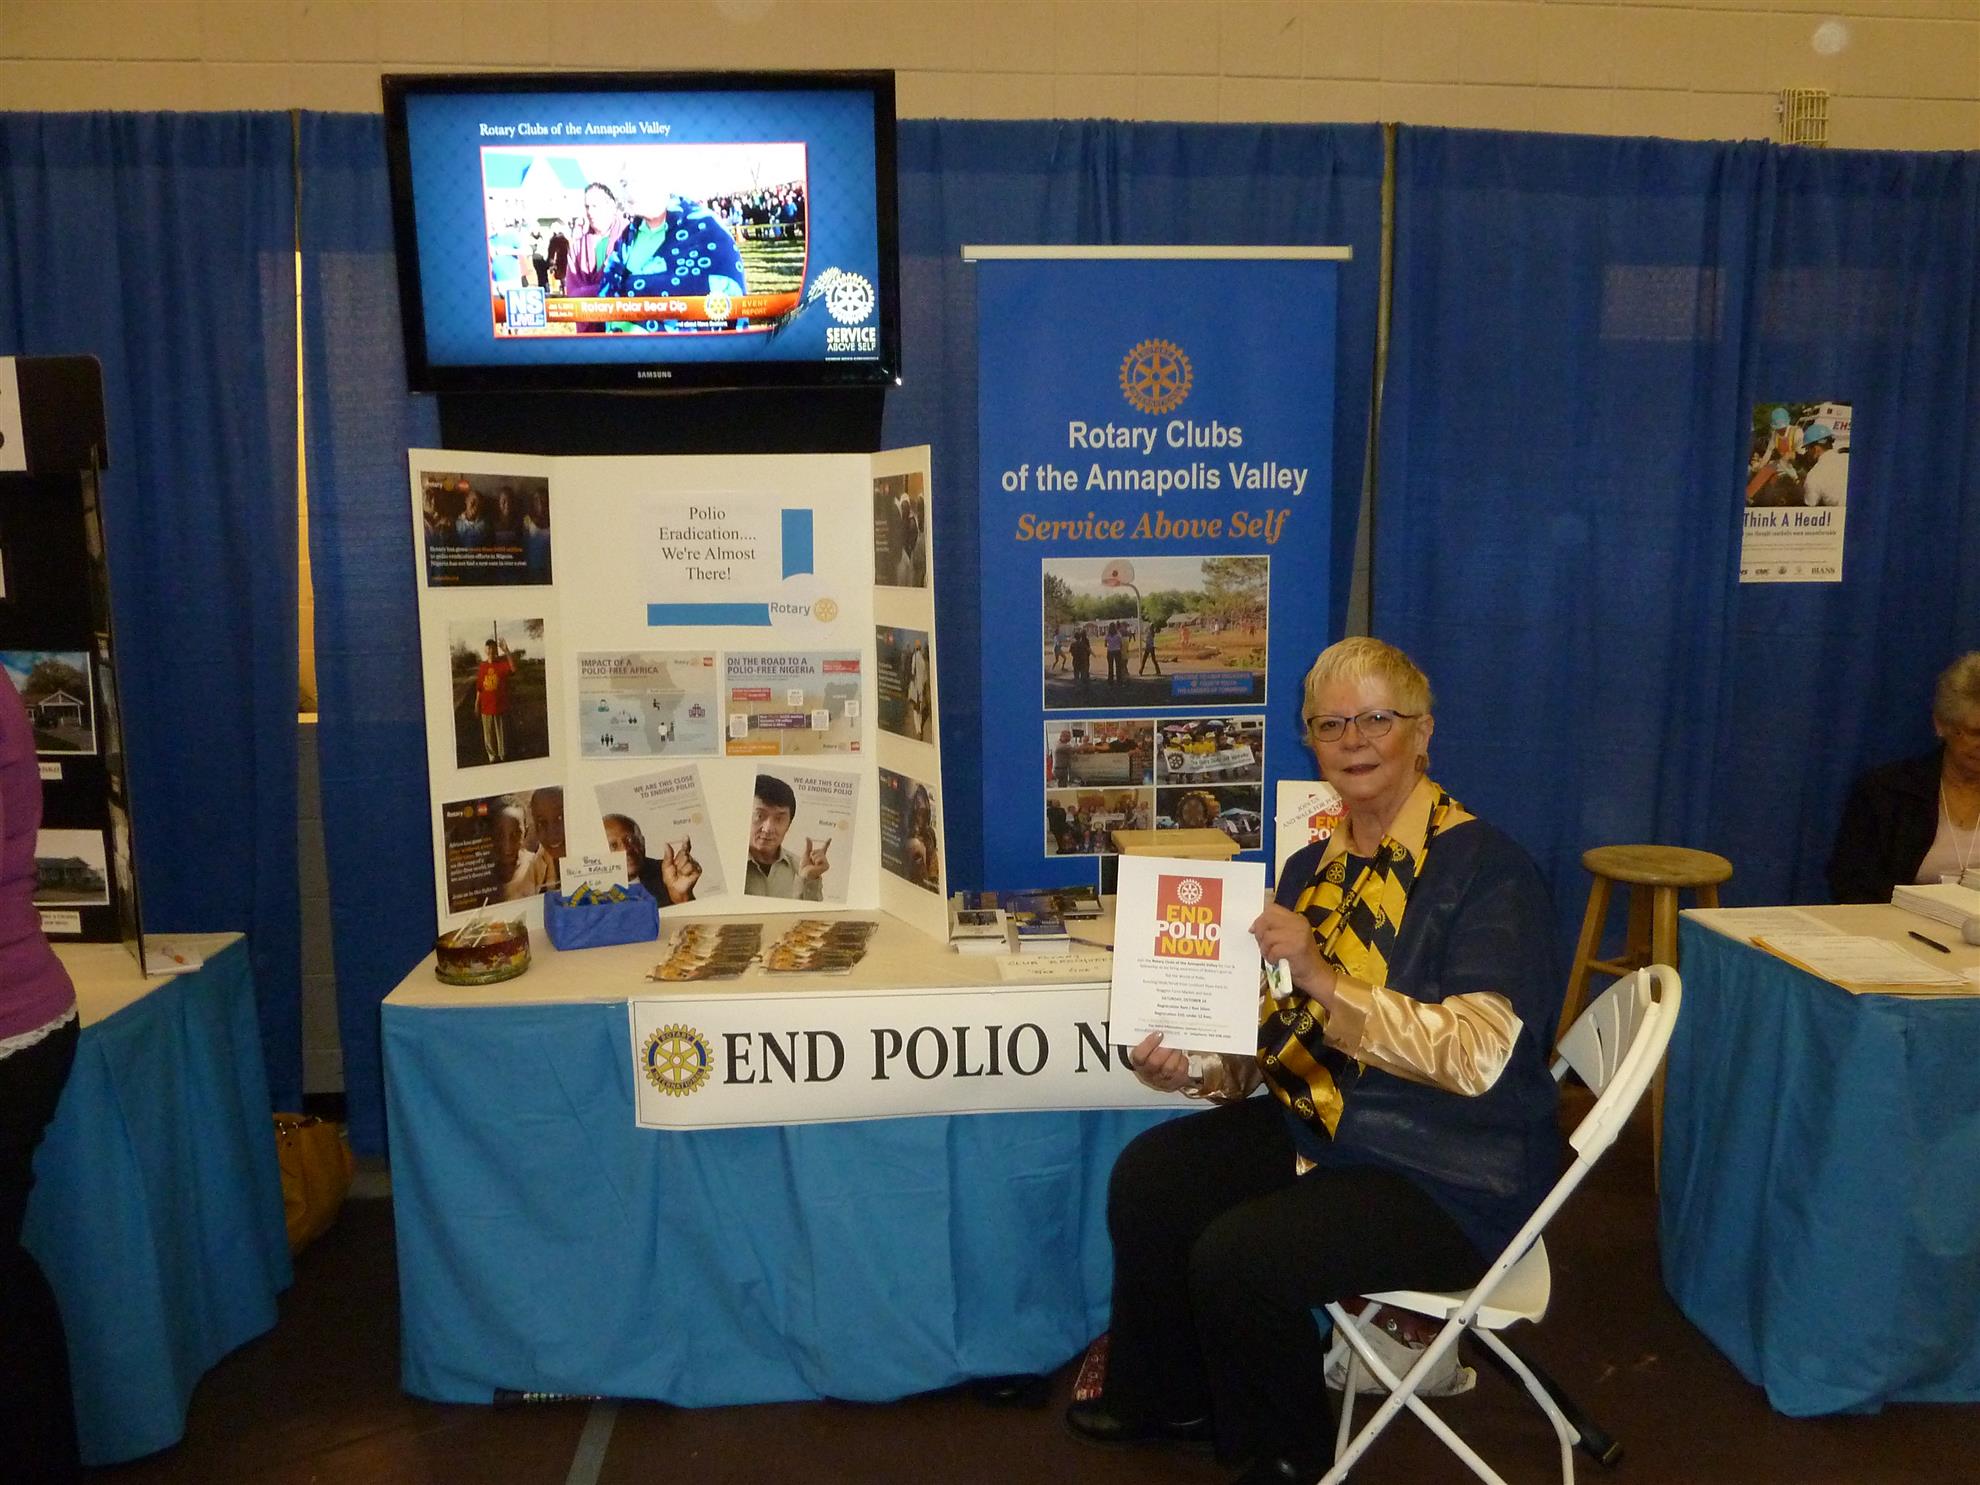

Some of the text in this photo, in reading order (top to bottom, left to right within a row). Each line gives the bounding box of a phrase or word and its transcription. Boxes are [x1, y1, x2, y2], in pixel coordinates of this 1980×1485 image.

[480, 121, 671, 138] Rotary Clubs of the Annapolis Valley
[508, 289, 544, 314] NS
[582, 301, 613, 315] Rotary
[616, 301, 642, 313] Polar
[644, 300, 667, 312] Bear
[669, 300, 688, 314] Dip
[826, 327, 876, 343] SERVICE
[827, 342, 876, 352] ABOVE SELF
[638, 370, 672, 378] SAMSUNG
[1068, 420, 1243, 455] Rotary Clubs
[1002, 462, 1308, 496] of the Annapolis Valley
[689, 506, 726, 520] Polio
[1744, 511, 1832, 528] Think A Head!
[659, 526, 756, 541] Eradication....
[1015, 508, 1292, 544] Service Above Self
[662, 546, 756, 560] We're Almost
[685, 567, 732, 580] There!
[770, 602, 810, 616] Rotary
[728, 658, 740, 666] ON
[742, 658, 759, 666] THE
[760, 658, 786, 666] ROAD
[788, 658, 799, 666] TO
[630, 666, 659, 674] AFRICA
[728, 666, 777, 674] POLIO-FREE
[779, 666, 815, 674] NIGERIA
[646, 784, 657, 792] ARE
[658, 780, 673, 790] THIS
[674, 776, 694, 786] CLOSE
[650, 786, 675, 798] ENDING
[676, 782, 695, 792] POLIO
[808, 785, 832, 794] ENDING
[832, 788, 853, 796] POLIO
[833, 781, 853, 790] CLOSE
[1315, 816, 1338, 829] EN
[1166, 904, 1212, 924] END
[1154, 920, 1221, 941] POLIO
[1162, 936, 1216, 956] NOW
[722, 1030, 845, 1084] END
[870, 1023, 1049, 1080] POLIO
